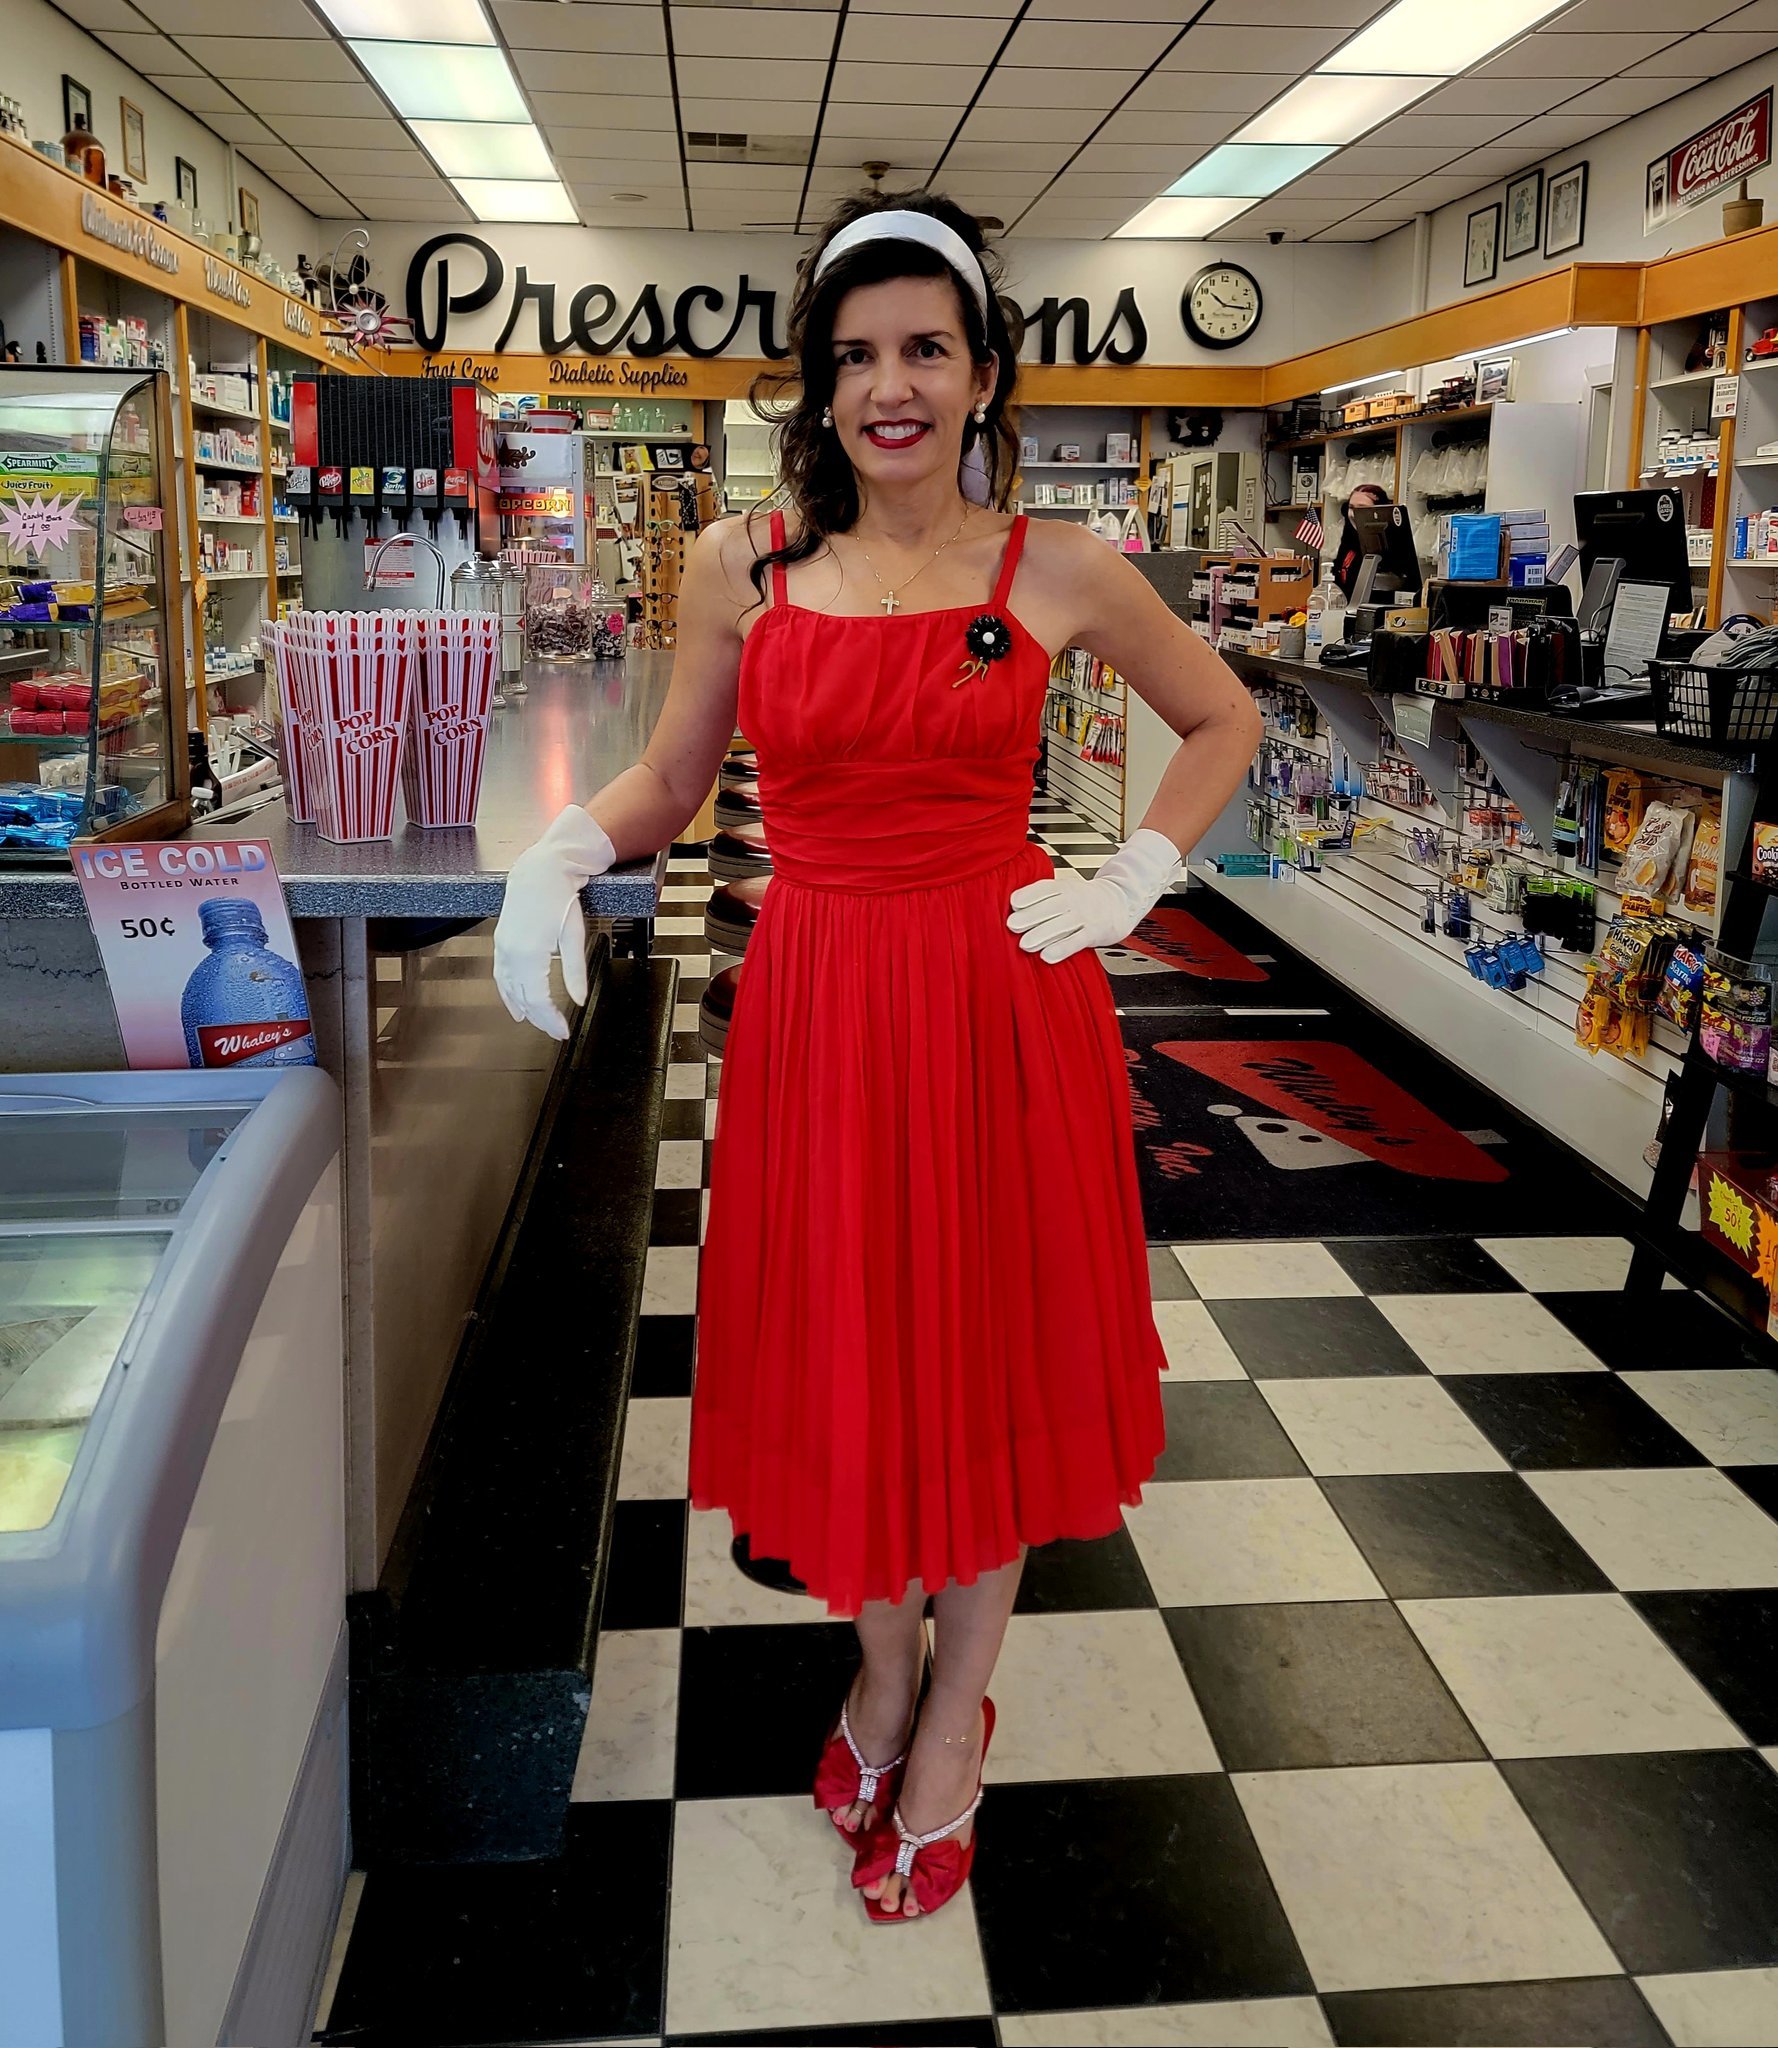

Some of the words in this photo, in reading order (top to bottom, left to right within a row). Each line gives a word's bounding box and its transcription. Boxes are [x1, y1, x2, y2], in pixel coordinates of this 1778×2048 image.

[1677, 106, 1759, 195] Coca-Cola
[1721, 153, 1758, 182] REFRESHING
[421, 356, 457, 378] Foot
[461, 357, 500, 383] Care
[549, 359, 615, 384] Diabetic
[619, 362, 688, 393] Supplies
[7, 458, 53, 468] SPEARMINT
[4, 481, 27, 489] Juicy
[28, 481, 50, 489] Fruit
[22, 512, 43, 521] Candy
[500, 498, 570, 512] OPCORN
[337, 711, 373, 735] POP
[425, 704, 460, 726] POP
[346, 724, 398, 755] CORN
[433, 716, 483, 746] CORN
[80, 848, 148, 879] ICE
[159, 844, 267, 875] COLD
[120, 879, 183, 891] BOTTLED
[189, 876, 239, 888] WATER
[120, 917, 176, 939] 50¢
[214, 1026, 292, 1056] Whaley's
